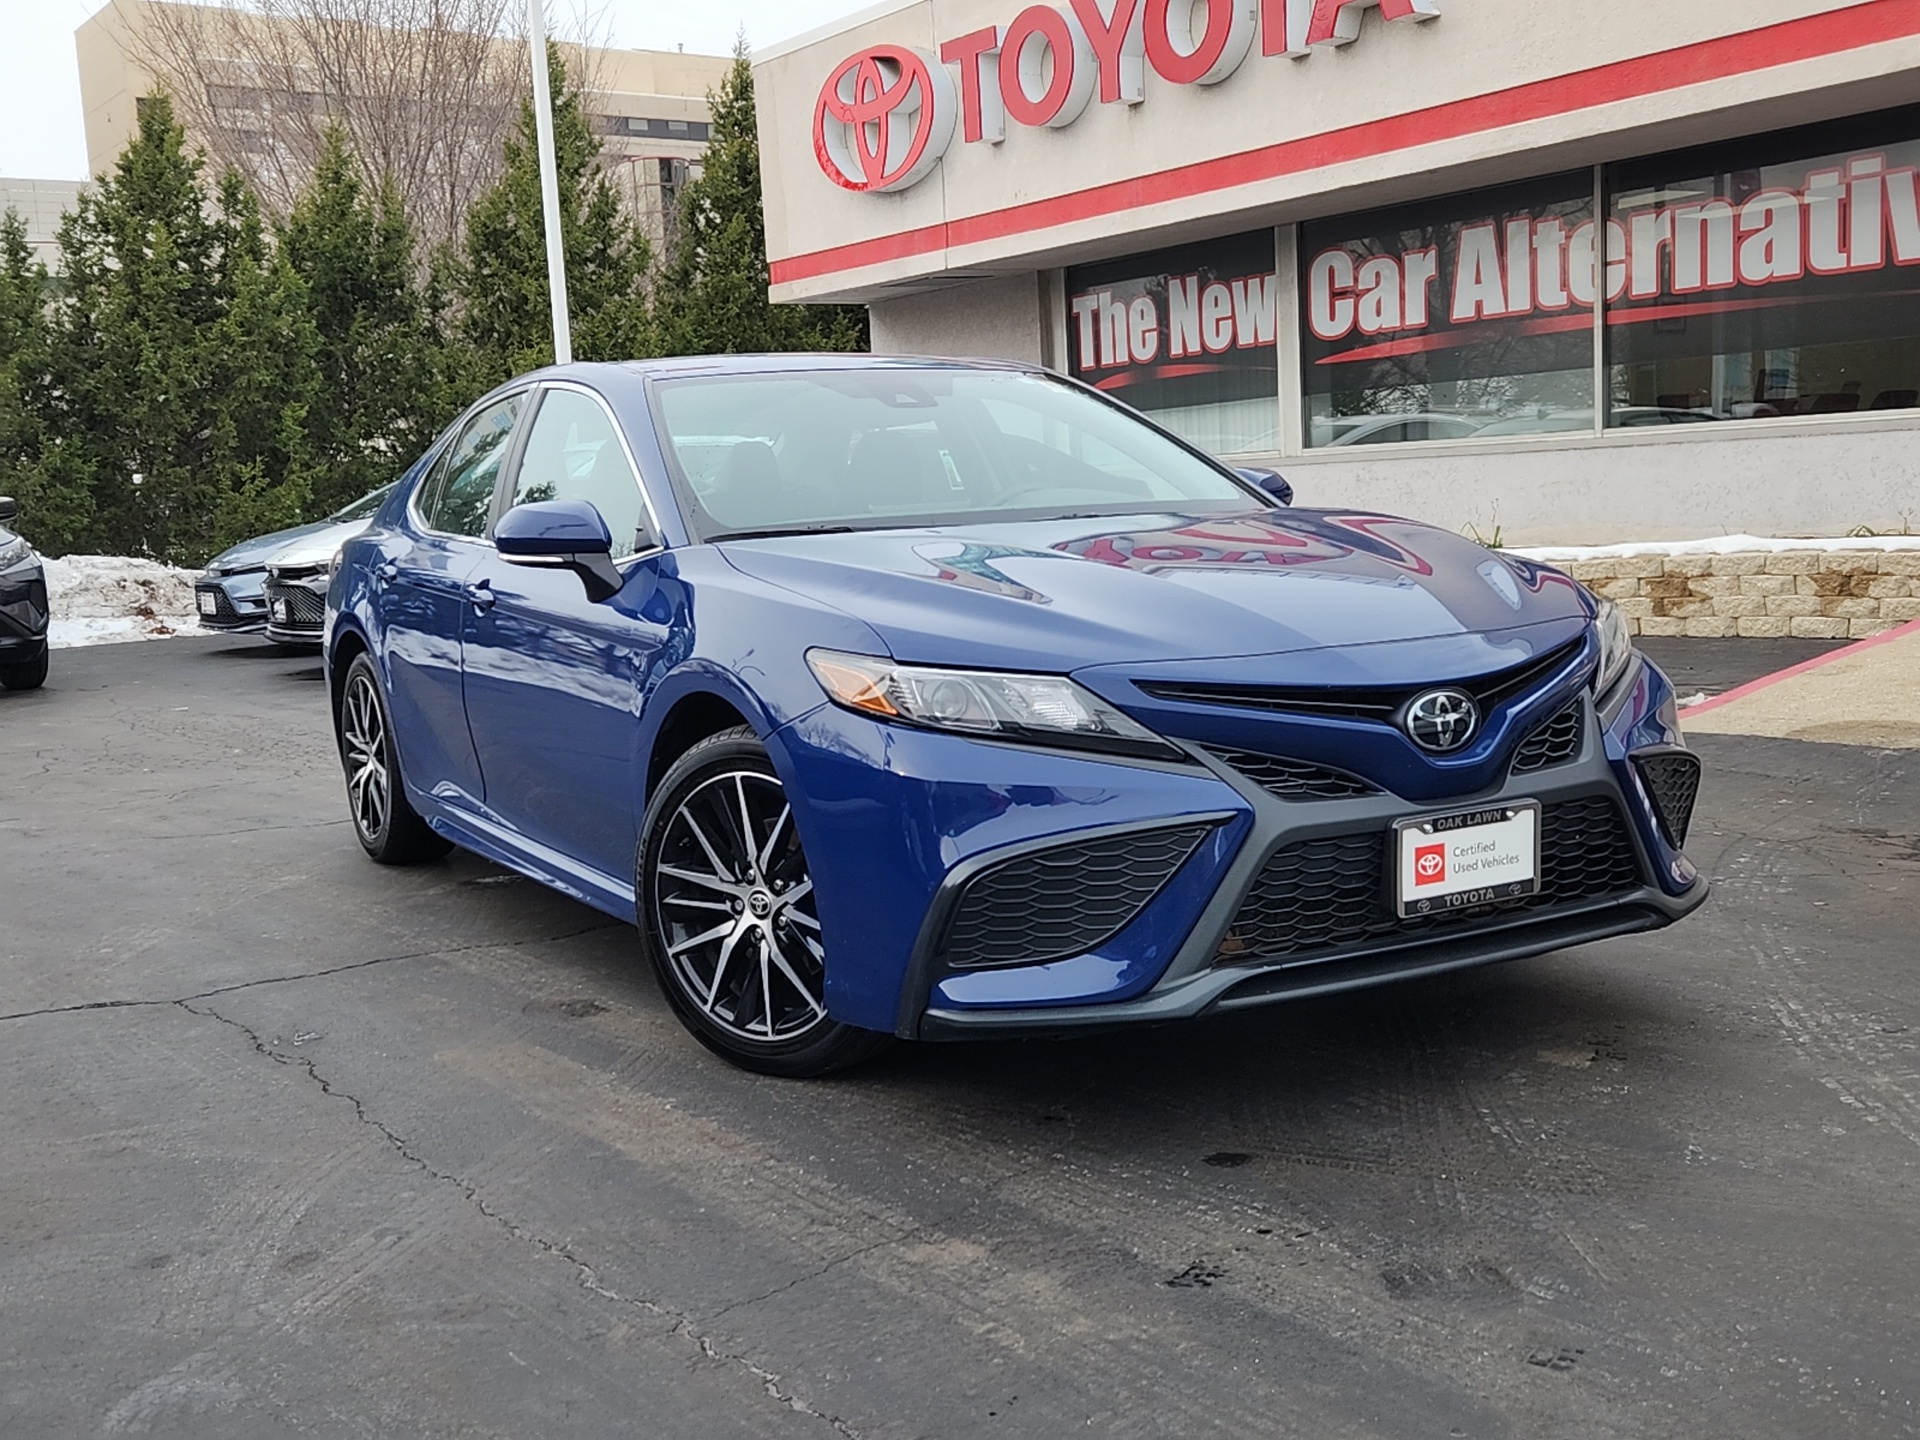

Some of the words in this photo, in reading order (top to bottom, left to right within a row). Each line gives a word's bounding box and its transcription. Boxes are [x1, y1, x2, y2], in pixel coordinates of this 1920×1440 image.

[1072, 288, 1159, 371] The
[1168, 272, 1276, 358] New
[1308, 246, 1438, 340] Car
[1437, 816, 1463, 830] OAK
[1467, 810, 1502, 825] LAWN
[1453, 840, 1496, 858] Certified
[1453, 859, 1478, 874] Used
[1480, 853, 1520, 869] Vehicles
[1444, 888, 1495, 907] TOYOTA
